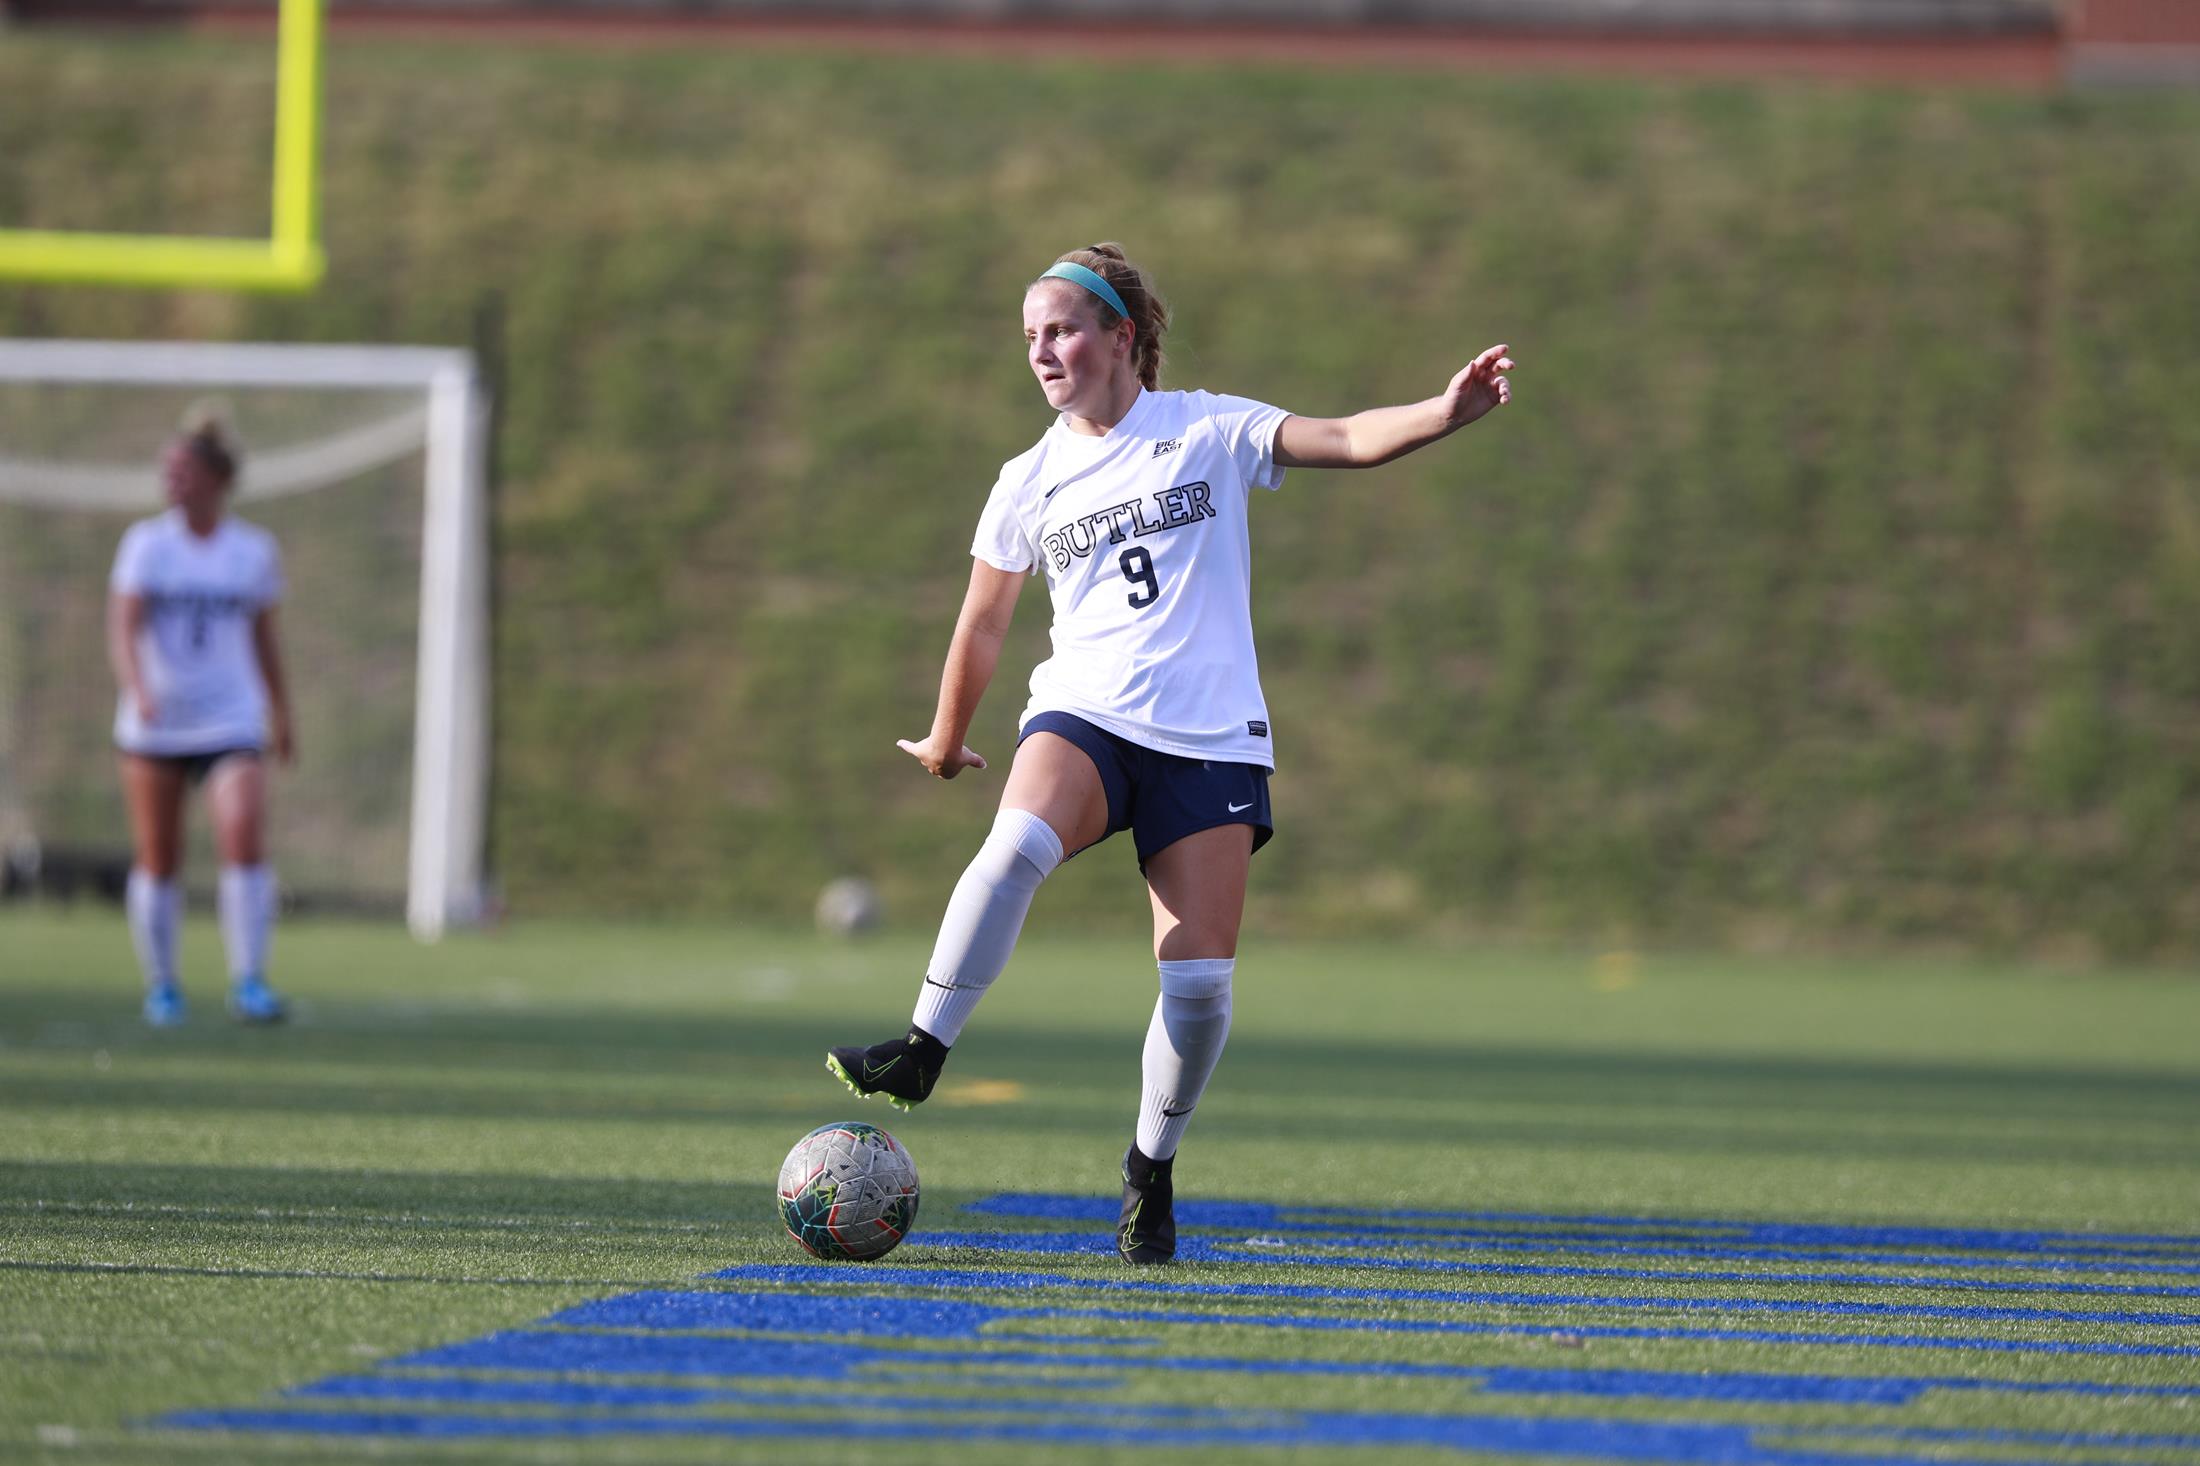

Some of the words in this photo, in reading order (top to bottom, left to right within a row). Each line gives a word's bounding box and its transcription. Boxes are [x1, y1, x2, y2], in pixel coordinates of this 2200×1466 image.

[1153, 443, 1183, 455] EAST
[1155, 438, 1176, 449] BIG
[1043, 480, 1216, 572] BUTLER
[1118, 545, 1160, 610] 9
